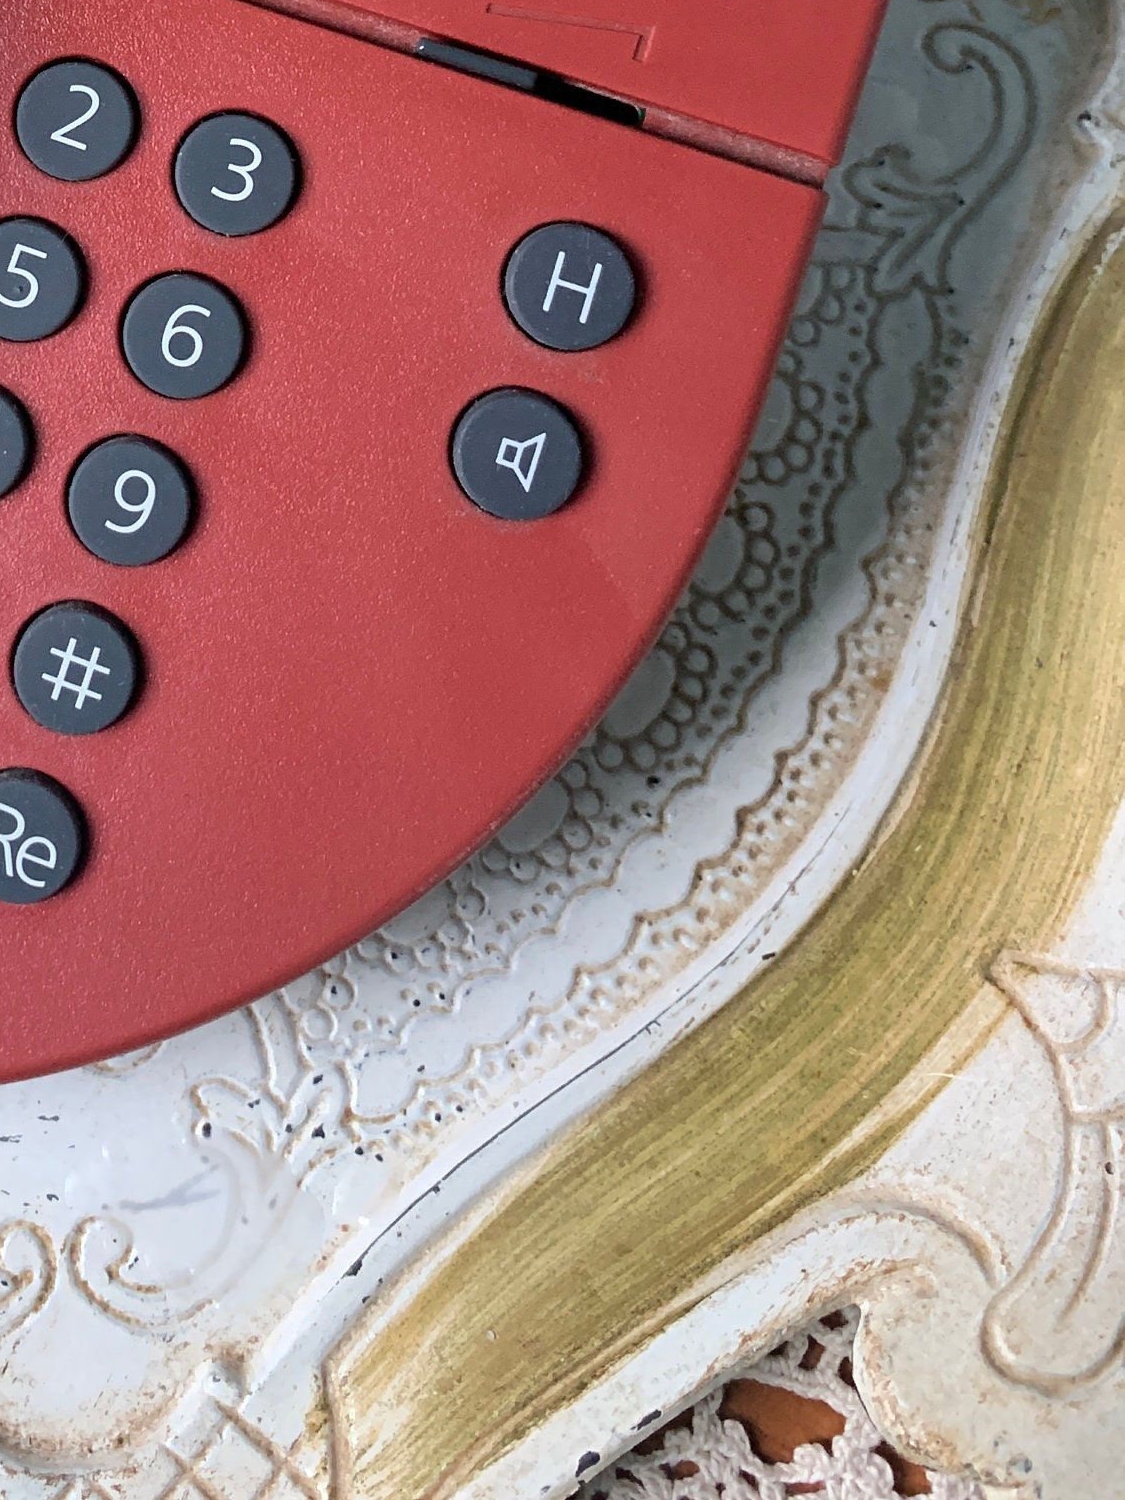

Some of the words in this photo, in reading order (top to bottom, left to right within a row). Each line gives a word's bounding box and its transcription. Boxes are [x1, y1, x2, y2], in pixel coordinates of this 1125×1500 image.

[50, 84, 100, 151] 2
[210, 138, 262, 202] 3
[542, 250, 603, 324] H
[161, 304, 211, 368] 6
[104, 469, 156, 534] 9
